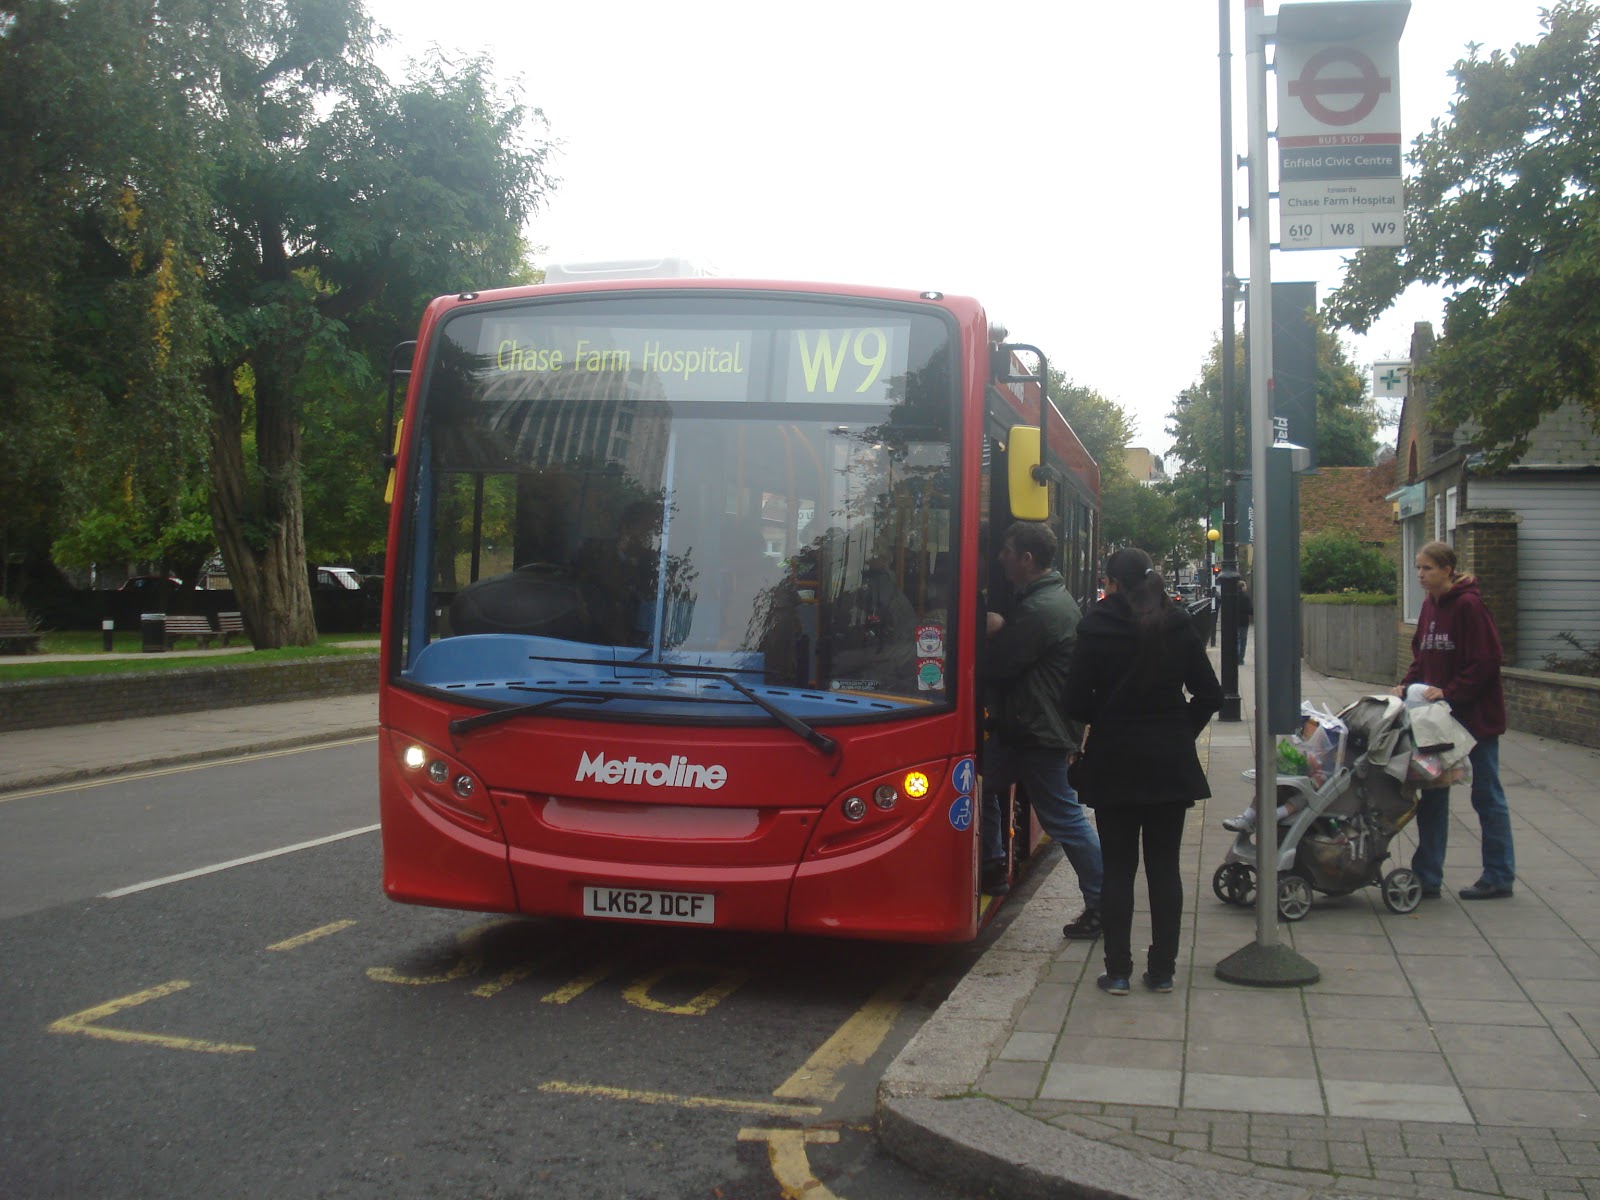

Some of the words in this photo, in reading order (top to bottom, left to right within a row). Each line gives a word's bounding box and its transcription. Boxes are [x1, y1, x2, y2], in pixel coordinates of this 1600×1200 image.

[1319, 135, 1337, 145] BUS
[1341, 135, 1365, 144] STOP
[1283, 156, 1322, 168] Enfield
[1325, 155, 1351, 166] Civic
[1355, 155, 1393, 166] Centre
[1327, 186, 1357, 194] towards
[1288, 197, 1320, 207] Chase
[1323, 196, 1349, 206] Farm
[1352, 195, 1396, 207] Hospital
[1289, 224, 1313, 237] 610
[1330, 223, 1355, 235] W8
[1371, 222, 1396, 234] W9
[496, 340, 563, 373] Chase
[574, 341, 631, 373] Farm
[642, 341, 743, 380] Hospital
[797, 327, 888, 393] W9
[575, 750, 727, 790] Metroline
[593, 890, 653, 915] LK62
[660, 894, 705, 918] DCF
